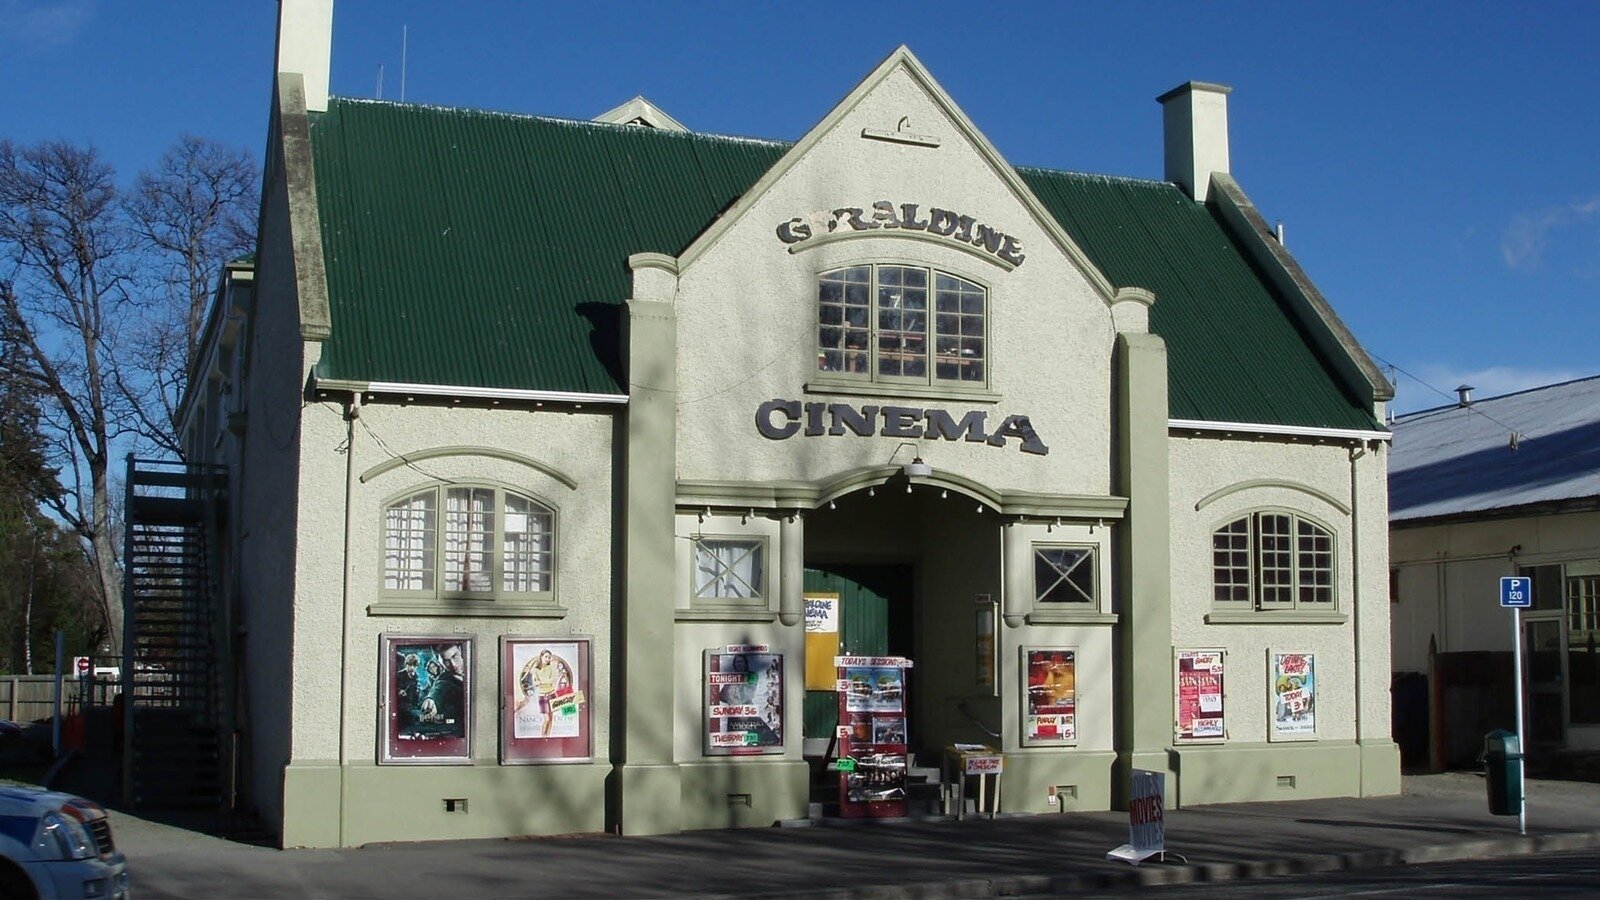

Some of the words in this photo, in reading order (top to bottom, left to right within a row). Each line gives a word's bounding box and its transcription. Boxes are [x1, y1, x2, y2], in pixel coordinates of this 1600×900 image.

[776, 200, 1025, 267] GRALDINE
[755, 399, 1049, 456] CINEMA
[1511, 580, 1520, 590] P
[1509, 591, 1522, 600] 120
[711, 675, 742, 684] TONIGHT
[713, 706, 743, 716] SUNDAY
[713, 732, 743, 742] TUESDAY
[1130, 794, 1163, 827] MOVIES
